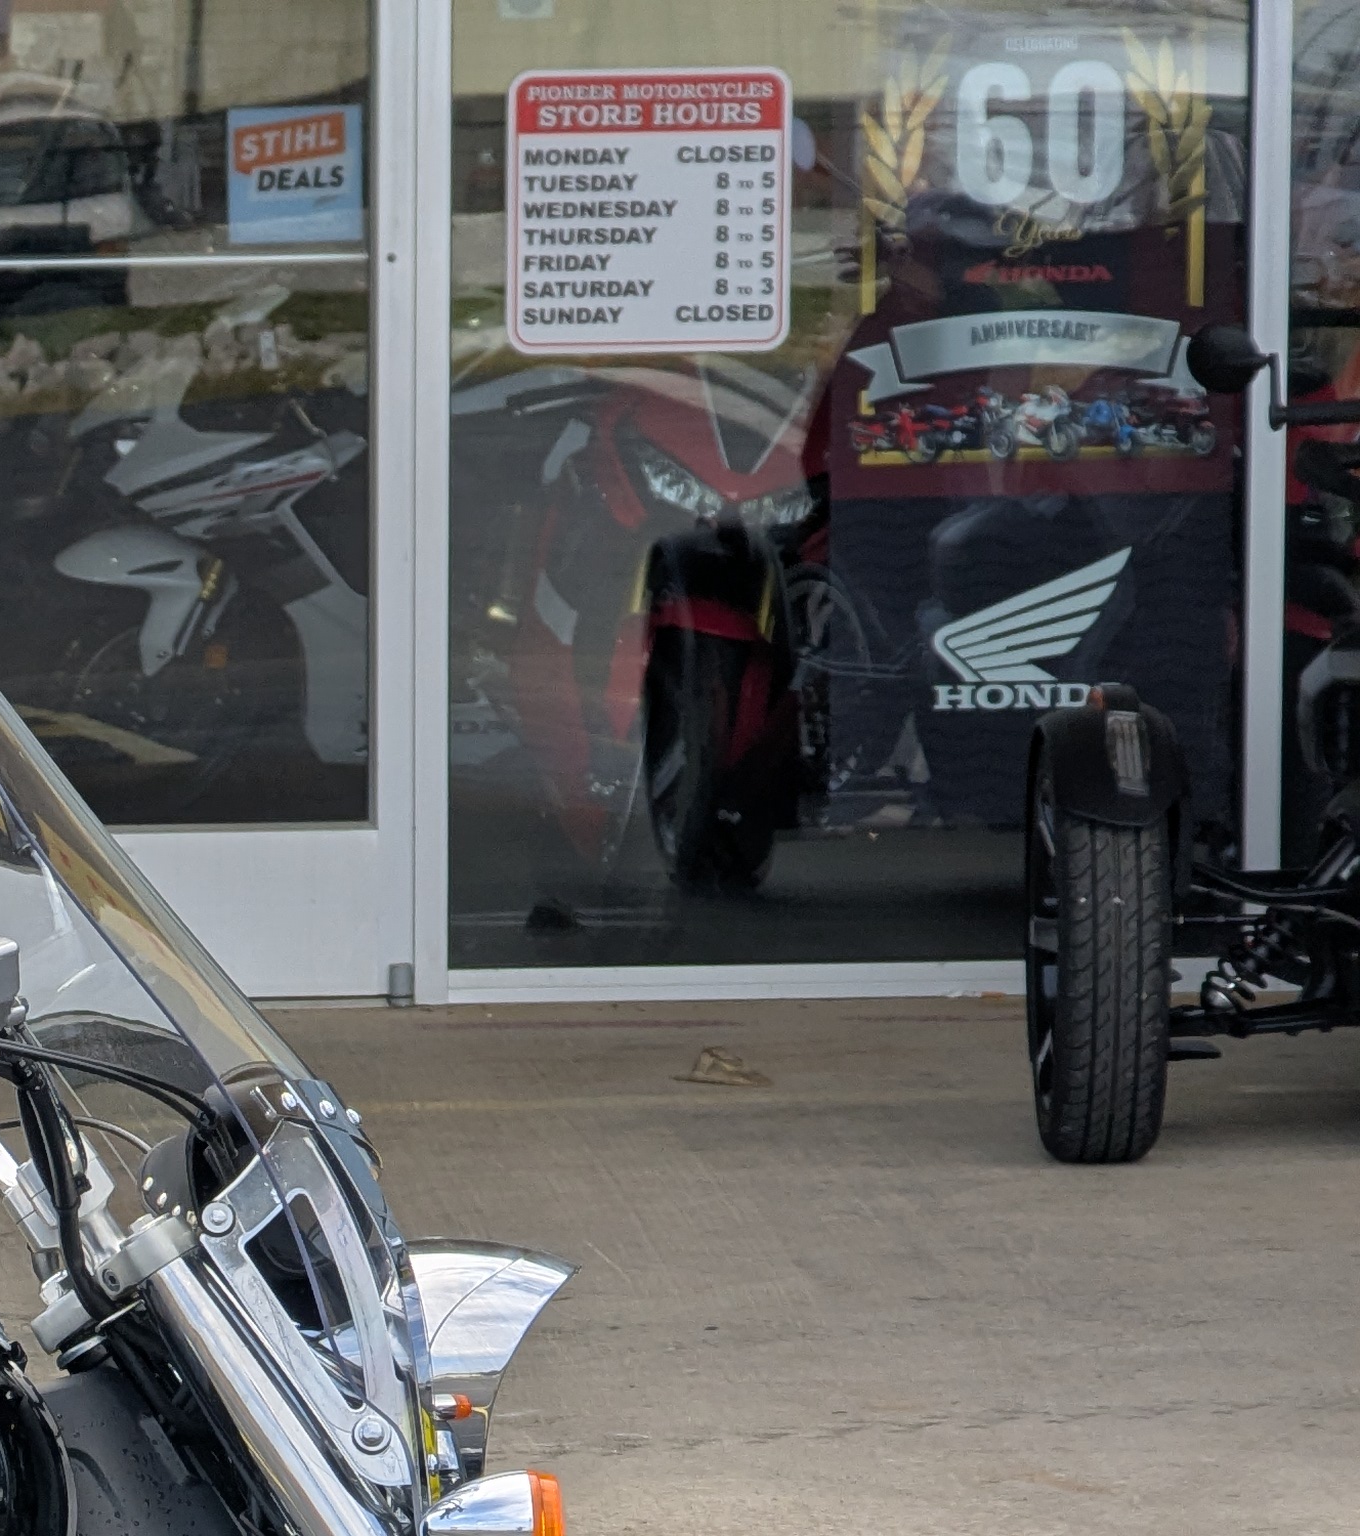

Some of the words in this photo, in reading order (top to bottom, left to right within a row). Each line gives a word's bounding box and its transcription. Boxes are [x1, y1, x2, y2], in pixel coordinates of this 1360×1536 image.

[528, 83, 615, 101] PIONEER
[623, 81, 774, 99] MOTORCYCLES
[538, 103, 643, 127] STORE
[653, 102, 762, 125] HOURS
[241, 124, 339, 161] STIHL
[957, 60, 1126, 205] 60
[524, 147, 630, 166] MONDAY
[677, 145, 775, 164] CLOSED
[257, 165, 345, 193] DEALS
[524, 174, 638, 192] TUESDAY
[716, 172, 730, 189] 8
[738, 179, 754, 189] TO
[762, 171, 775, 188] 5
[523, 200, 679, 219] WEDNESDAY
[716, 198, 729, 216] 8
[738, 205, 754, 215] TO
[761, 198, 775, 215] 5
[524, 227, 658, 245] THURSDAY
[715, 225, 729, 242] 8
[761, 225, 775, 242] 5
[523, 254, 611, 272] FRIDAY
[715, 251, 728, 269] 8
[737, 259, 753, 269] TO
[761, 251, 775, 268] 5
[998, 265, 1113, 283] HONDA
[524, 280, 654, 298] SATURDAY
[715, 278, 728, 295] 8
[761, 278, 774, 294] 3
[524, 306, 624, 325] SUNDAY
[676, 304, 774, 322] CLOSED
[971, 318, 1101, 345] ANNIVERSARY
[933, 682, 1094, 711] HOND
